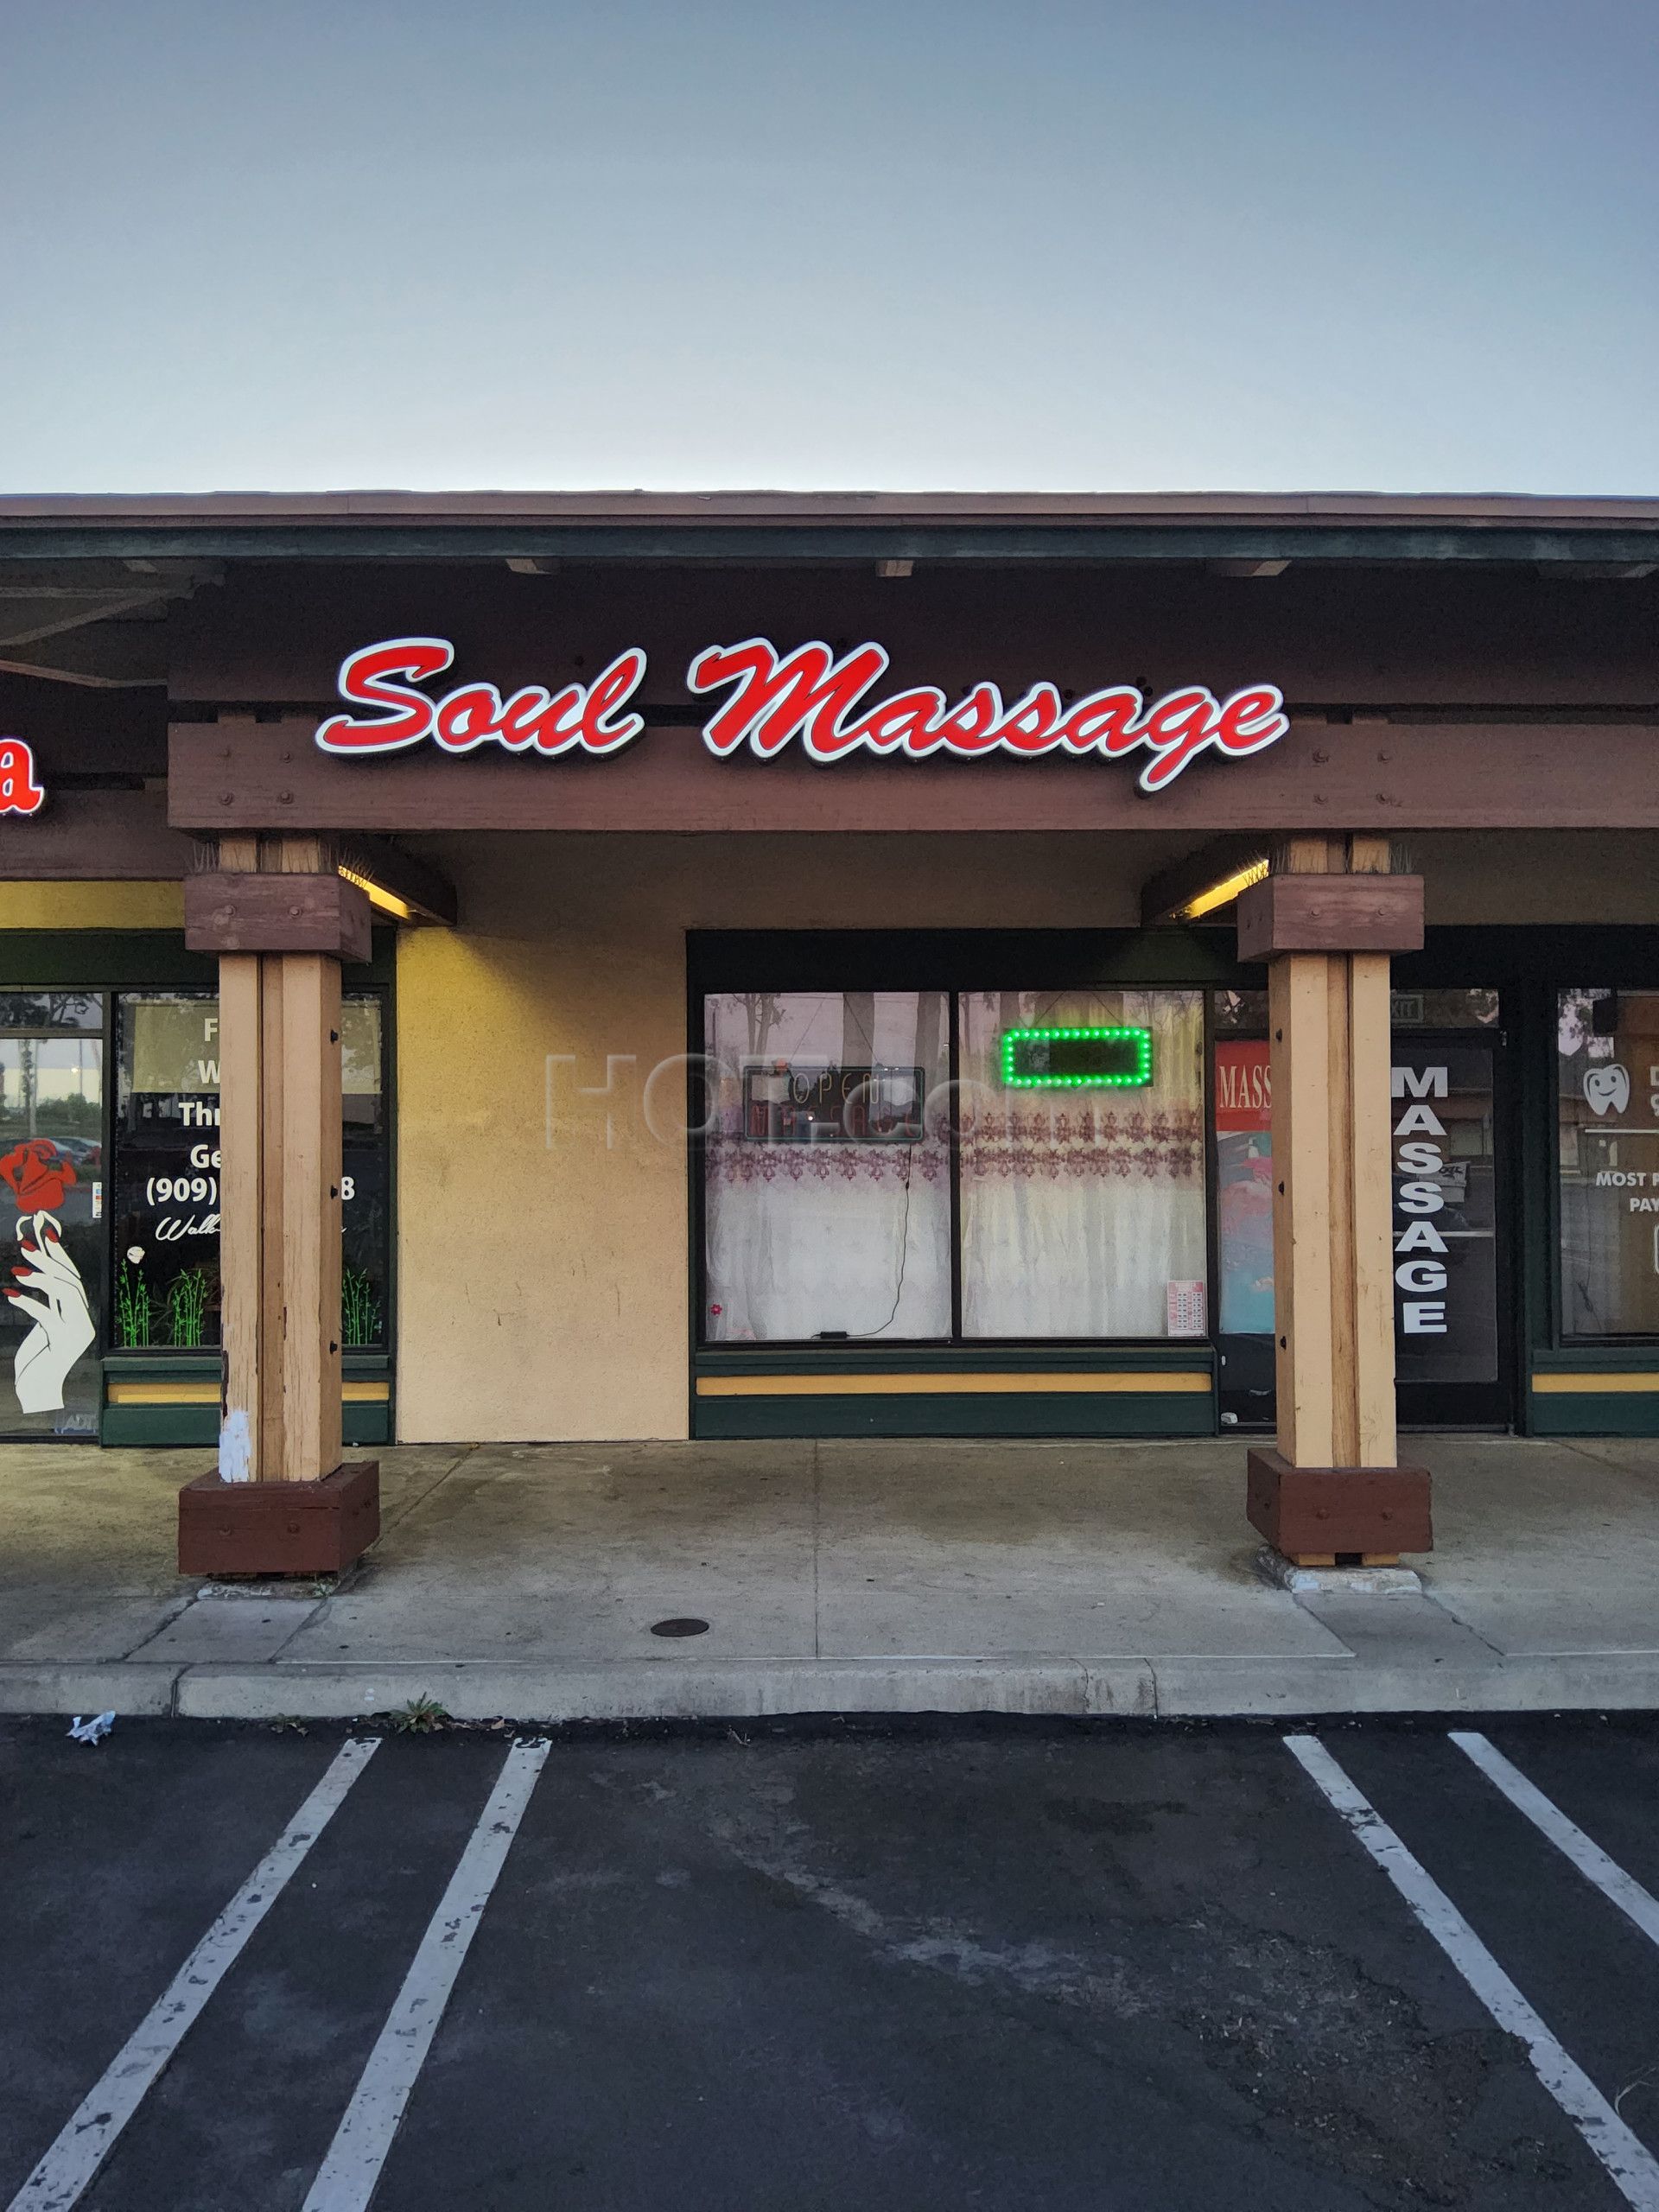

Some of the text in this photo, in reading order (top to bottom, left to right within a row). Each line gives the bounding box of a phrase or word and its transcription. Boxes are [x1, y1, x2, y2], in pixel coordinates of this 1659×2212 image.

[314, 637, 1290, 792] Soul Massage
[793, 1071, 880, 1104] OPEN
[1219, 1064, 1272, 1110] MASS
[147, 1176, 217, 1206] (909)
[1595, 1172, 1647, 1187] MOST
[1391, 1066, 1449, 1334] MASSAGE
